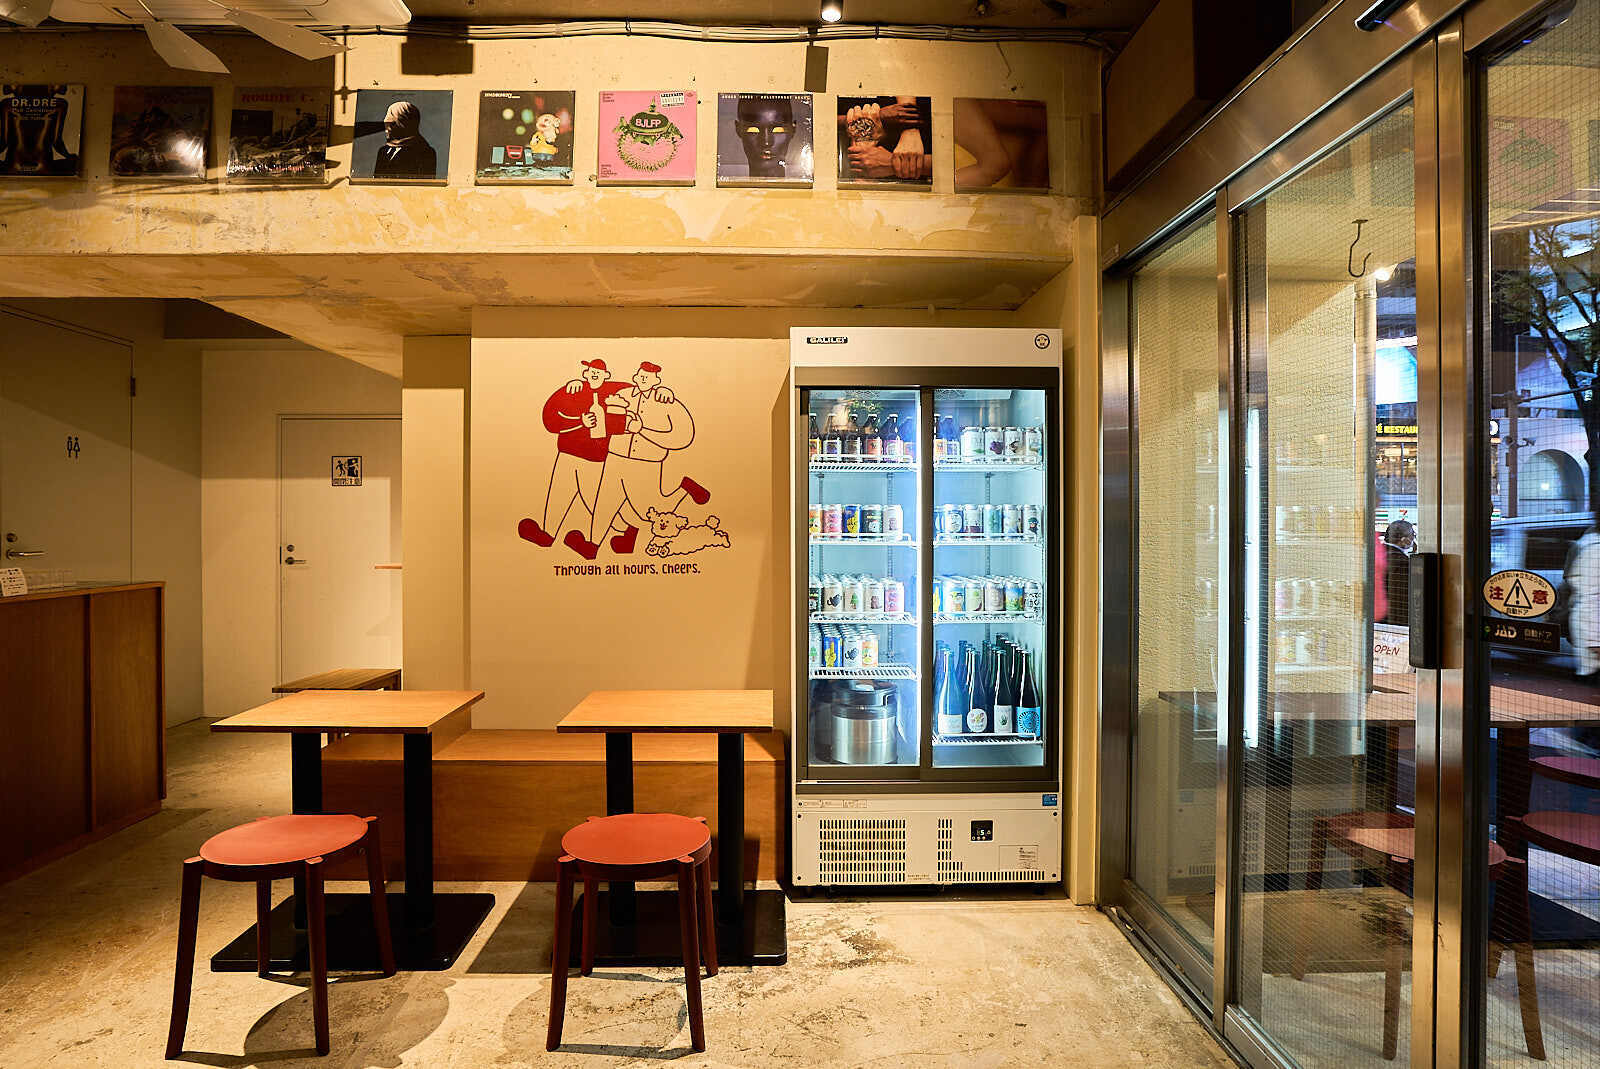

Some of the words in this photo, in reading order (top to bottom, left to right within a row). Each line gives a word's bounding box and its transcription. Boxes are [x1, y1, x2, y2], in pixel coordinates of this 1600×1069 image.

[11, 98, 57, 107] DR.DRE
[553, 565, 601, 576] Through
[605, 565, 620, 575] all
[1489, 586, 1504, 600] 注
[1532, 590, 1549, 605] 意
[1374, 644, 1401, 656] OPEN
